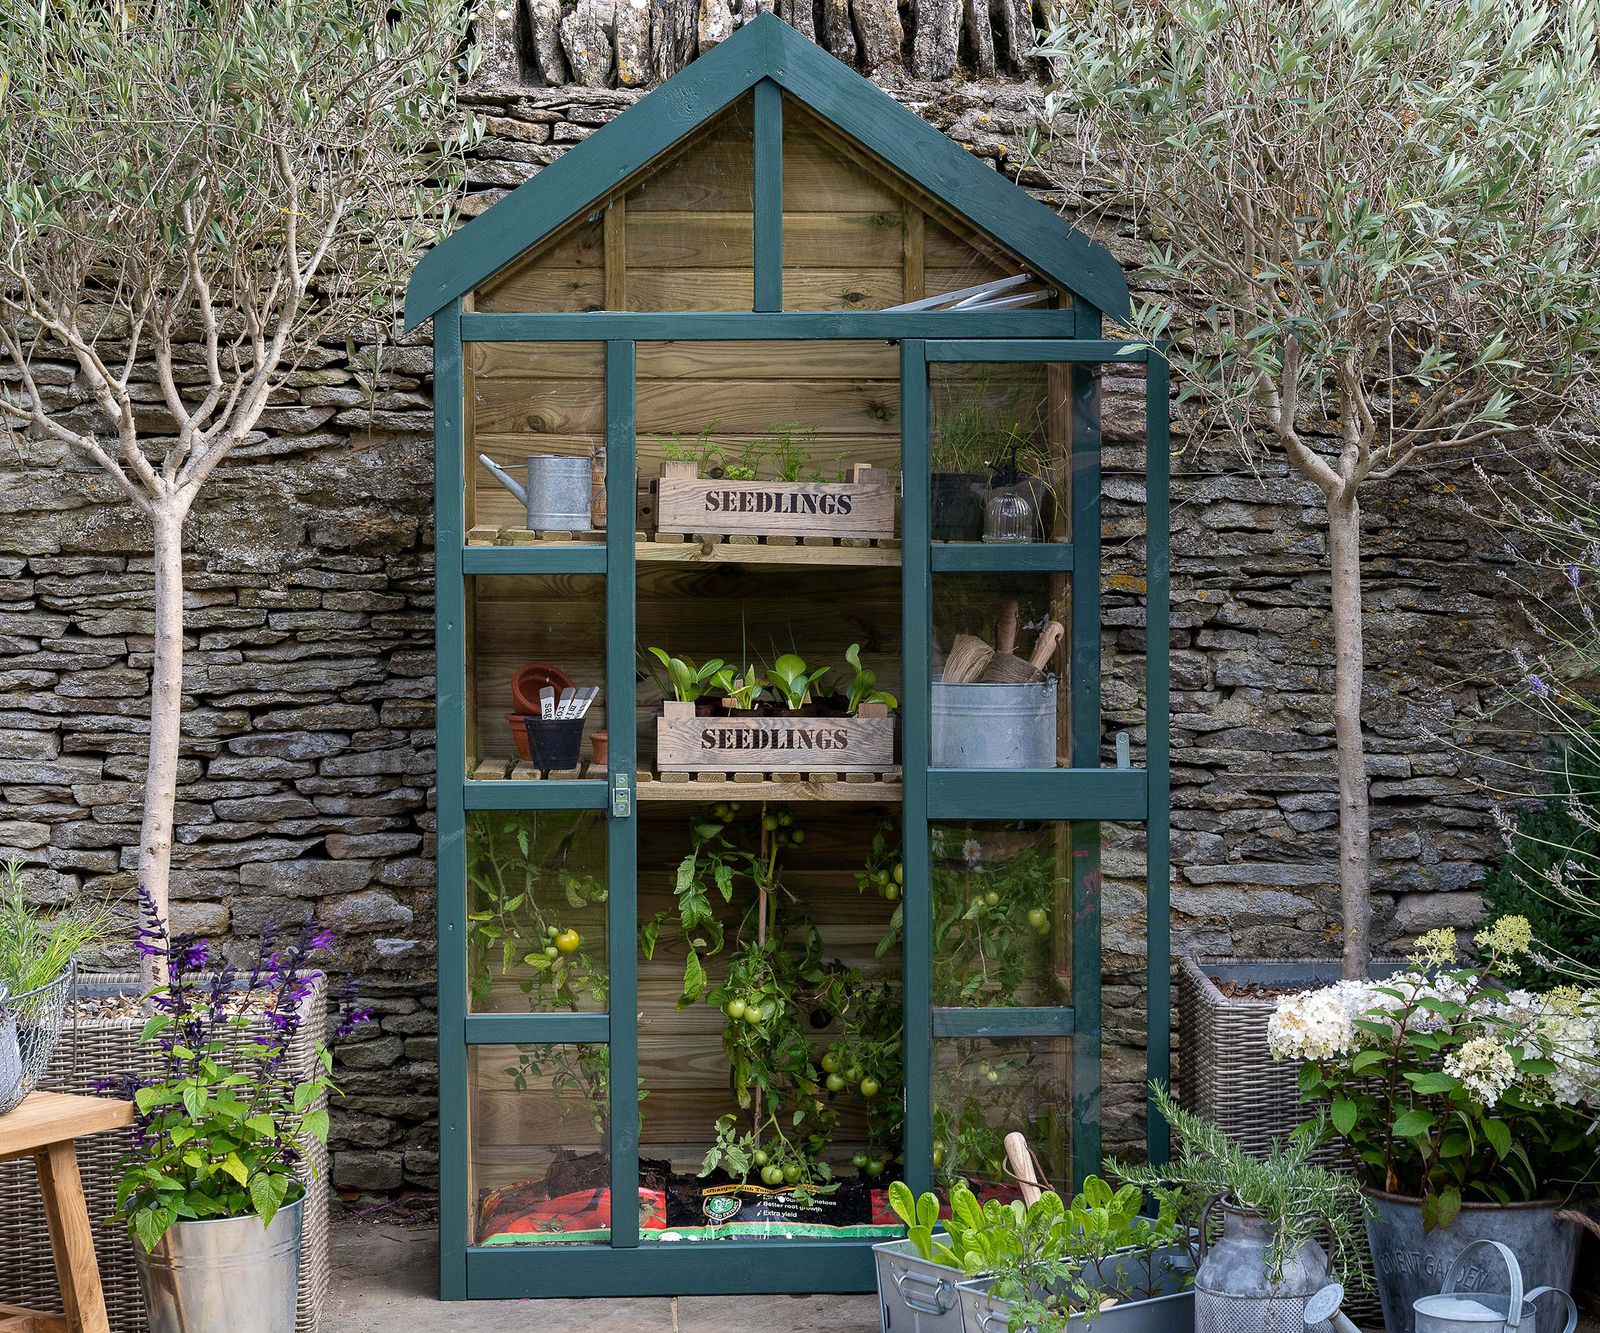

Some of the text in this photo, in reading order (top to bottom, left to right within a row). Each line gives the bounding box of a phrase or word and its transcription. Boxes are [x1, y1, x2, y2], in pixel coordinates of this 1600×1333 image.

[705, 490, 851, 515] SEEDLINGS
[701, 728, 848, 750] SEEDLINGS
[763, 1200, 784, 1208] Better
[763, 1209, 780, 1217] Extra
